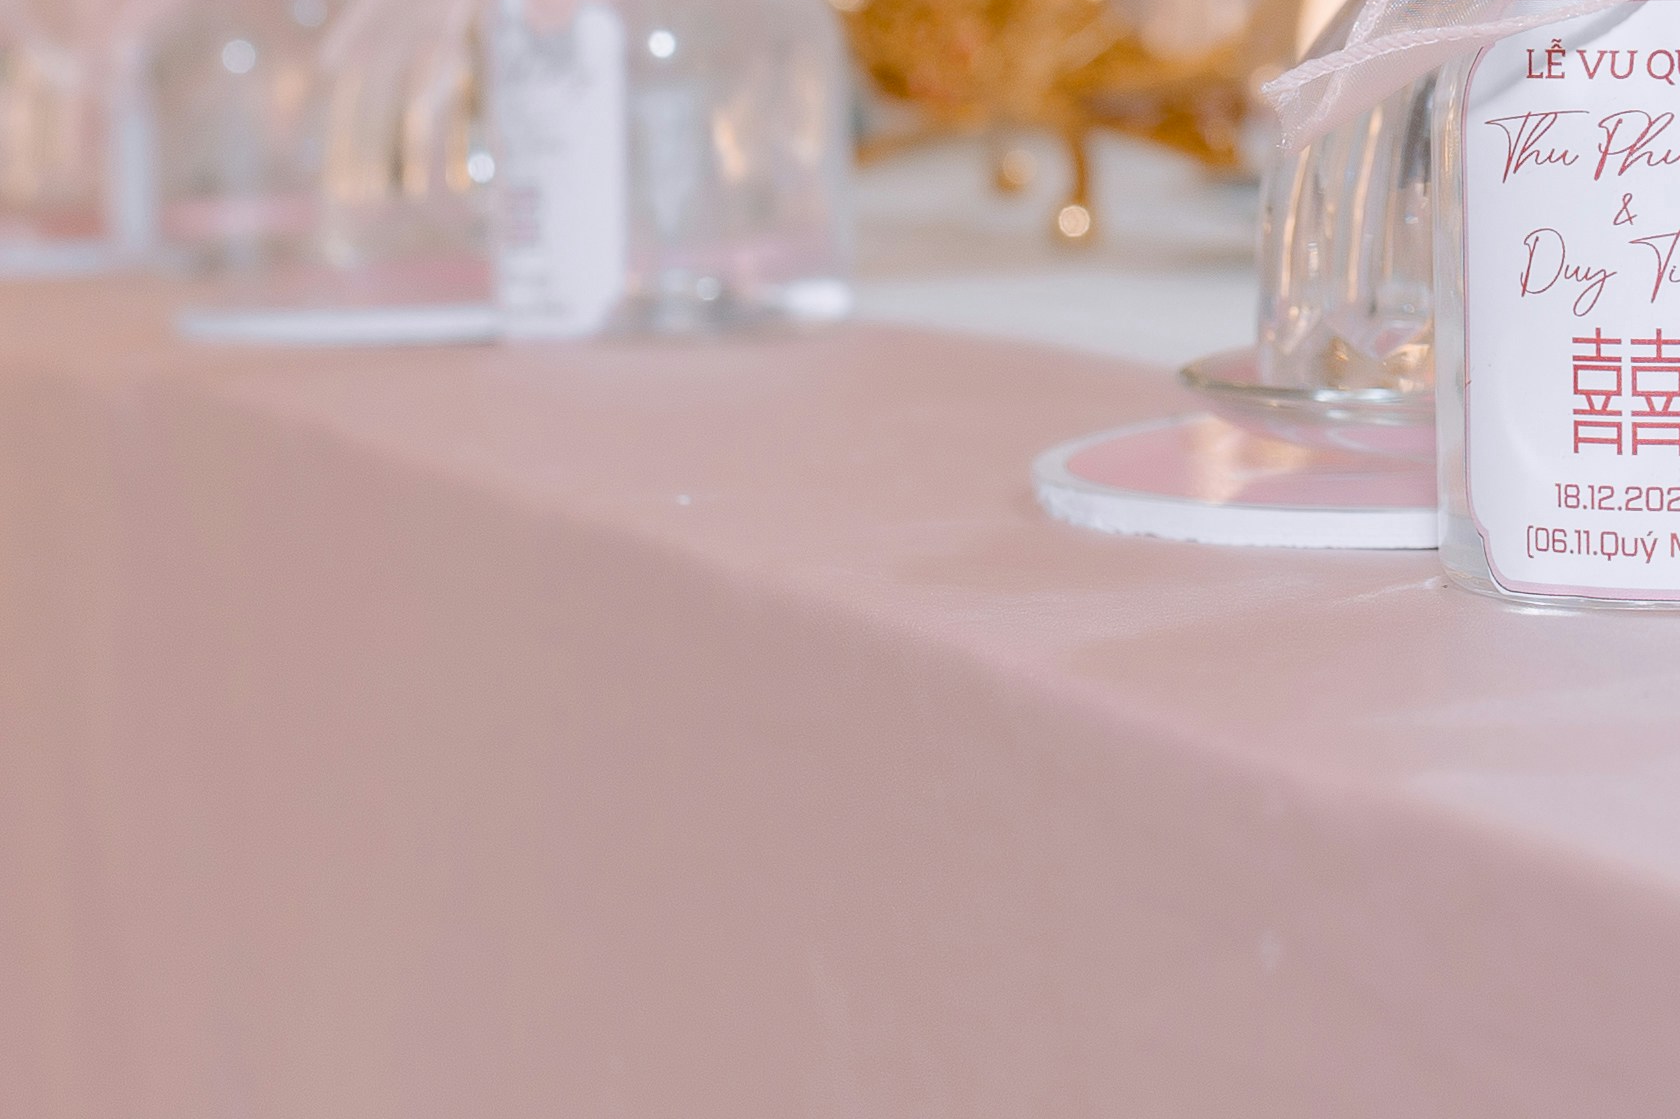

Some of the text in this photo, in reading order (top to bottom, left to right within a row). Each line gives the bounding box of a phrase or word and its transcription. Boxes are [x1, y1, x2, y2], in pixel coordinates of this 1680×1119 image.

[1525, 39, 1567, 80] LỄ
[1574, 44, 1638, 79] VU
[1484, 111, 1589, 184] Thu
[1613, 193, 1637, 225] &
[1520, 228, 1617, 317] Duy
